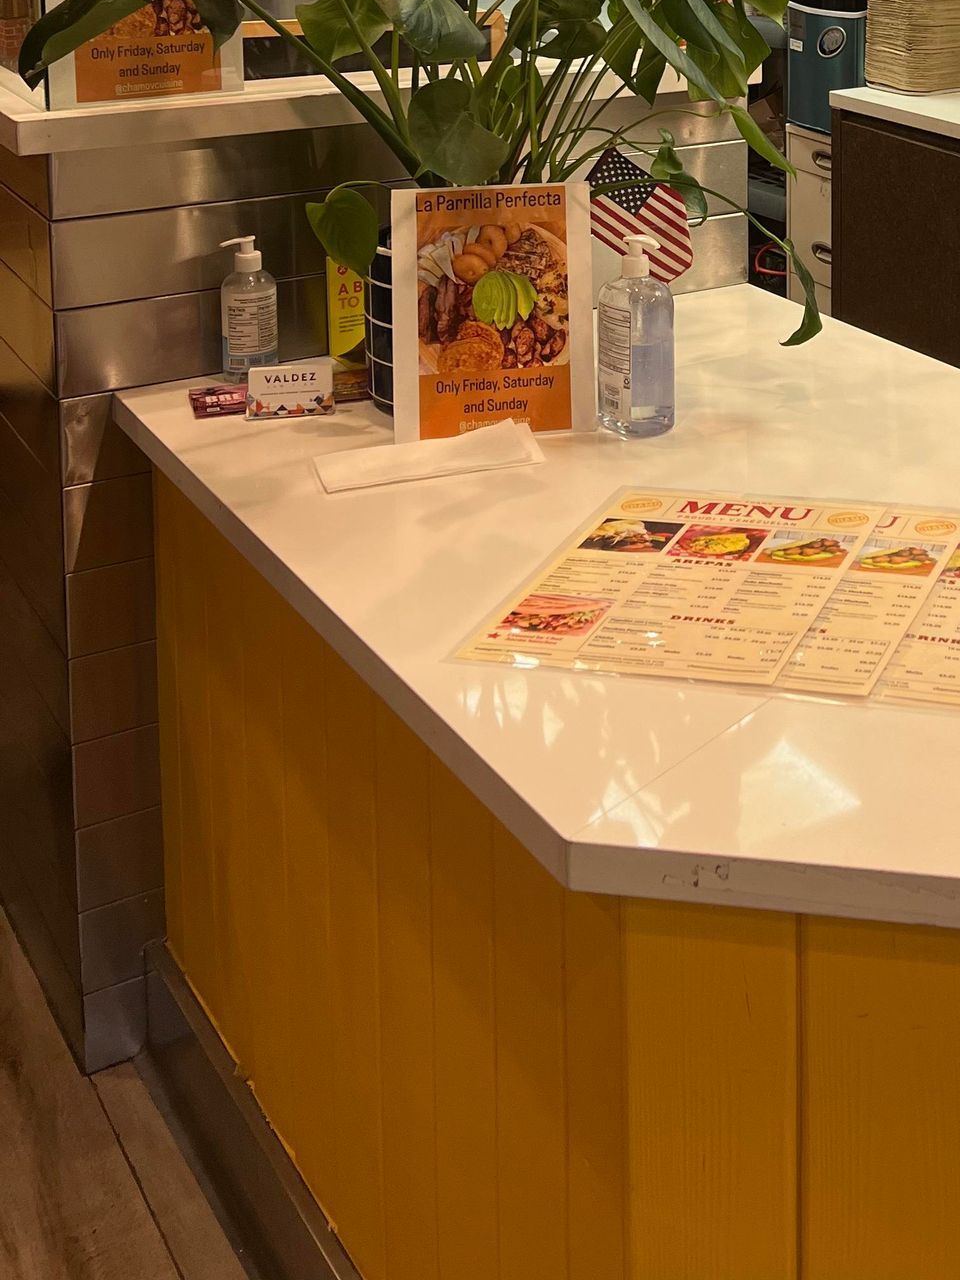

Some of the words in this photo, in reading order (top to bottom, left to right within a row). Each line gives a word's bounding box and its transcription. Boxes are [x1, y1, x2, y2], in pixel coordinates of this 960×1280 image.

[91, 48, 115, 61] Only
[118, 45, 154, 59] Friday,
[156, 42, 205, 54] Saturday
[119, 65, 139, 77] and
[141, 63, 181, 76] Sunday
[416, 195, 433, 213] La
[436, 193, 492, 211] Parrilla
[496, 192, 561, 208] Perfecta
[265, 373, 316, 383] VALDEZ
[436, 379, 460, 395] Only
[463, 377, 500, 393] Friday,
[503, 374, 555, 391] Saturday
[463, 399, 484, 413] and
[487, 397, 528, 412] Sunday
[678, 501, 815, 520] MENU
[672, 558, 733, 567] AREPAS
[670, 615, 736, 625] DRINKS
